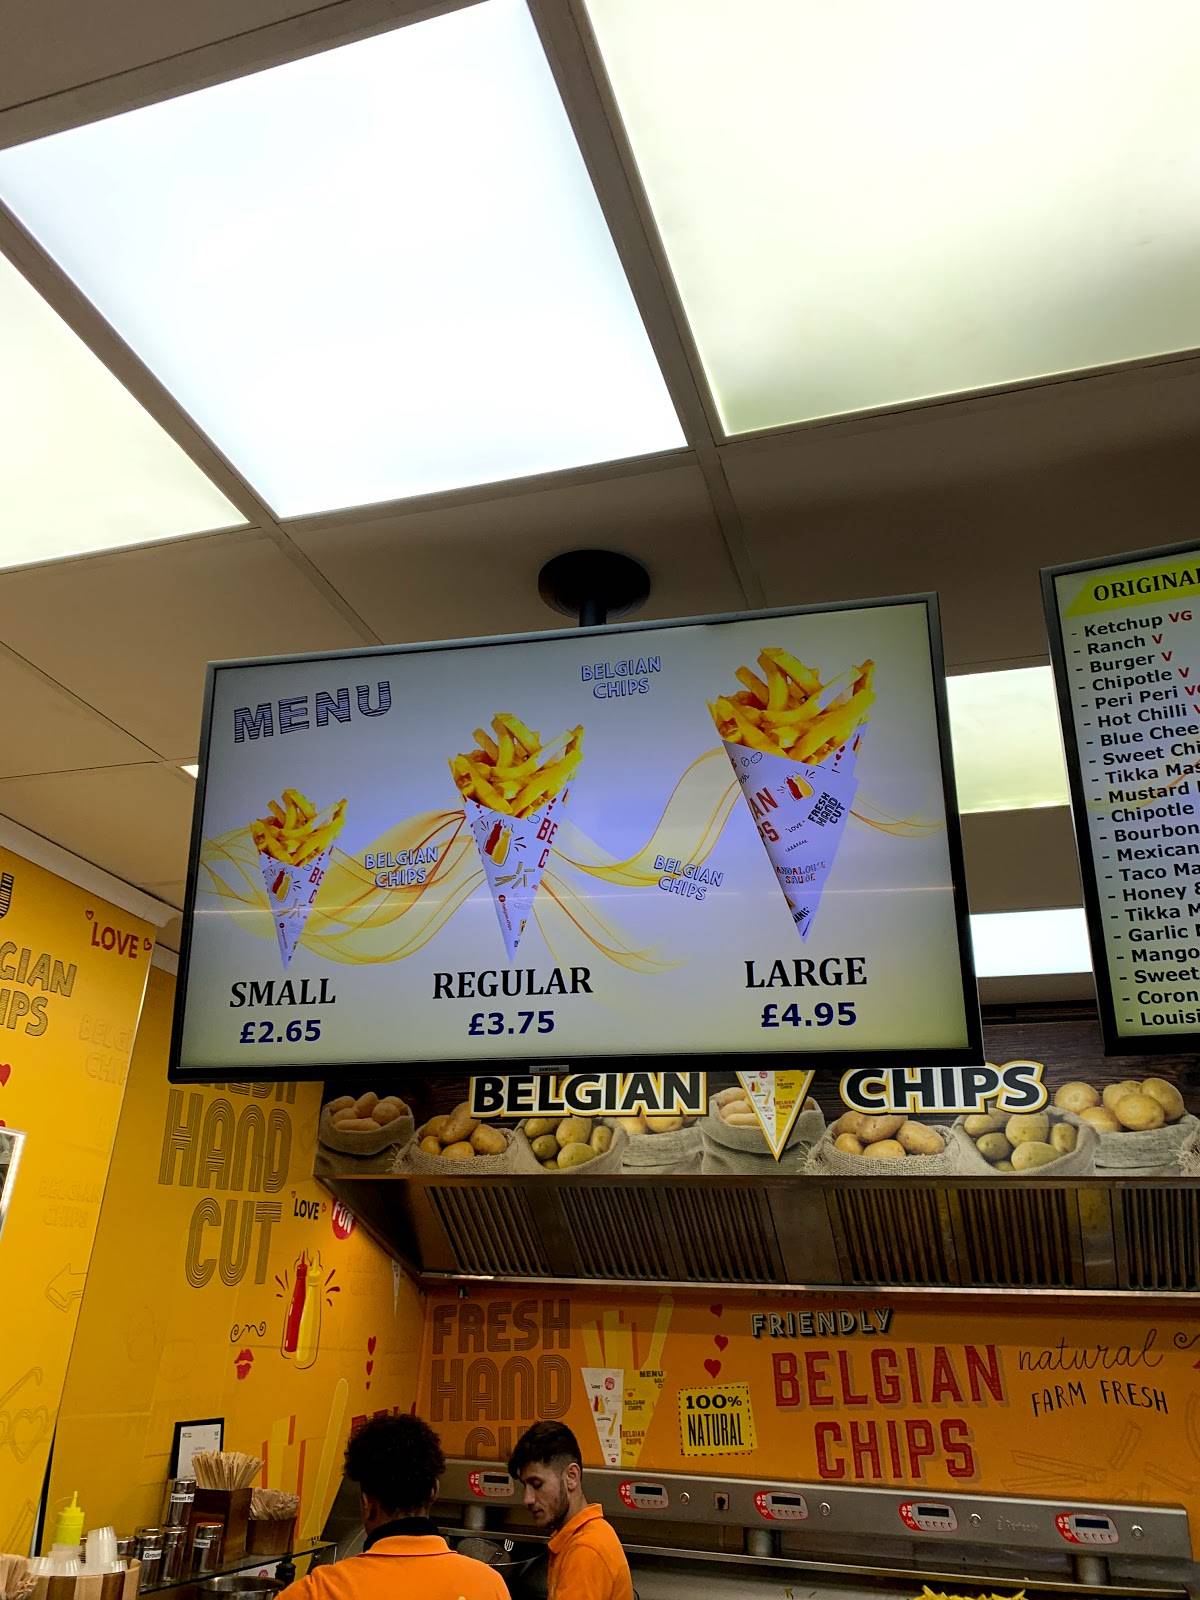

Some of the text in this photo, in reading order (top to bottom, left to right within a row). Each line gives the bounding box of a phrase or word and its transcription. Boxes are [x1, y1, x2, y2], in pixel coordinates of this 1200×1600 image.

[1084, 610, 1193, 637] Ketchup VG
[1088, 634, 1164, 655] Ranch V
[581, 656, 662, 682] BELGIAN
[1090, 651, 1173, 673] Burger V
[593, 677, 650, 699] CHIPS
[1092, 667, 1190, 691] Chipotle V
[1095, 693, 1133, 710] Peri
[1140, 686, 1178, 704] Peri
[234, 681, 393, 743] MENU
[1098, 712, 1132, 728] Hot
[1138, 704, 1187, 722] Chilli
[1100, 731, 1144, 747] Blue
[1103, 746, 1164, 766] Sweet
[1105, 767, 1159, 784] Tikka
[1109, 781, 1189, 803] Mustard
[1112, 802, 1194, 822] Chipotle
[1115, 824, 1200, 842] Bourbon
[365, 847, 438, 870] BELGIAN
[1117, 844, 1200, 861] Mexican
[375, 867, 427, 889] CHIPS
[653, 854, 724, 888] BELGIAN
[1119, 867, 1167, 881] Taco
[658, 876, 707, 901] CHIPS
[1123, 886, 1187, 901] Honey
[1124, 905, 1181, 921] Tikka
[91, 921, 139, 959] LOVE
[1128, 924, 1188, 942] Garlic
[1131, 947, 1200, 963] Mango
[432, 966, 594, 1000] REGULAR
[744, 956, 869, 989] LARGE
[1134, 967, 1200, 984] Sweet
[229, 978, 336, 1008] SMALL
[1137, 990, 1199, 1005] Coron
[468, 1010, 555, 1036] £3.75
[760, 1001, 857, 1028] £4.95
[239, 1019, 321, 1044] £2.65
[472, 1064, 1042, 1114] BELGIAN CHIPS
[158, 1089, 292, 1193] HAND
[293, 1198, 320, 1220] LOVE
[332, 1200, 355, 1234] FUN
[185, 1197, 284, 1288] CUT
[432, 1299, 570, 1354] FRESH
[751, 1306, 894, 1338] FRIENDLY
[1019, 1329, 1163, 1371] natural
[772, 1344, 1005, 1407] BELGIAN
[430, 1355, 571, 1422] HAND
[1031, 1380, 1168, 1417] FARM FRESH
[686, 1394, 742, 1409] 100%
[688, 1412, 744, 1446] NATURAL
[814, 1419, 976, 1479] CHIPS
